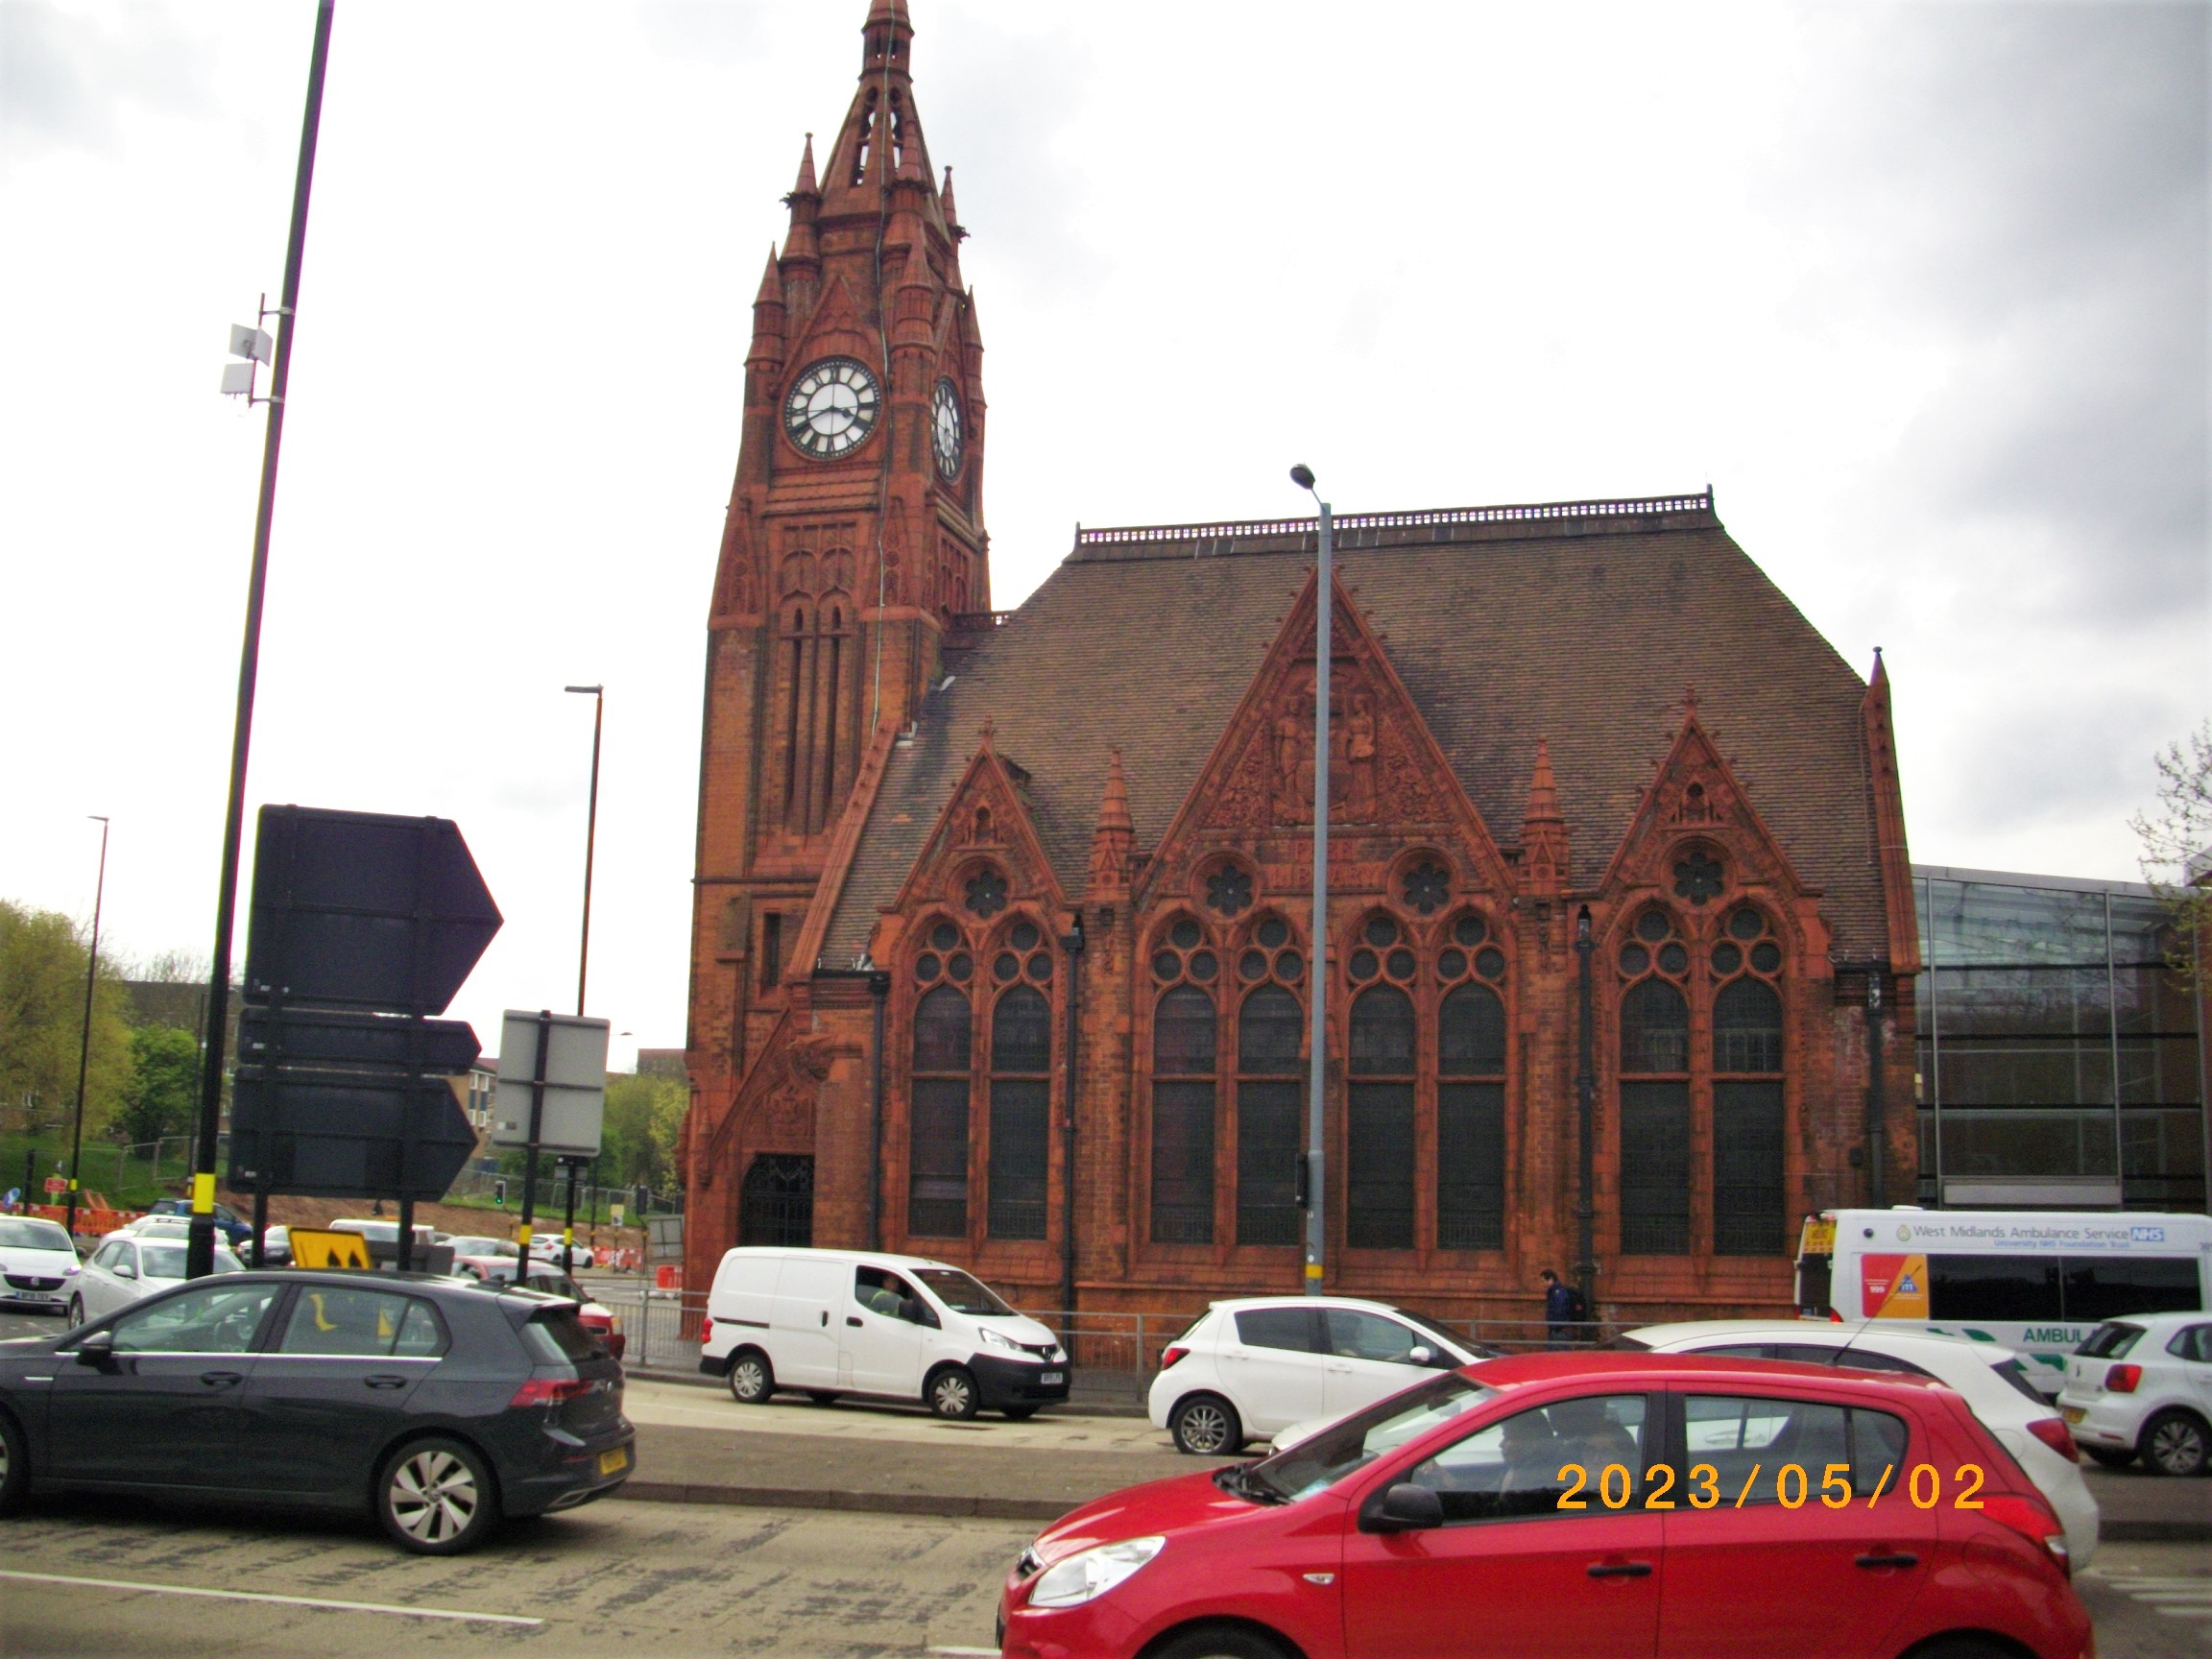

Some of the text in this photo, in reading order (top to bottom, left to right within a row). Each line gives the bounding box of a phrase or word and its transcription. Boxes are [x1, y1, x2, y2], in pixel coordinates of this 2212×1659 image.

[1913, 1225, 2163, 1240] West Midlands Ambulance Service NHS
[2023, 1327, 2089, 1343] AMBUL
